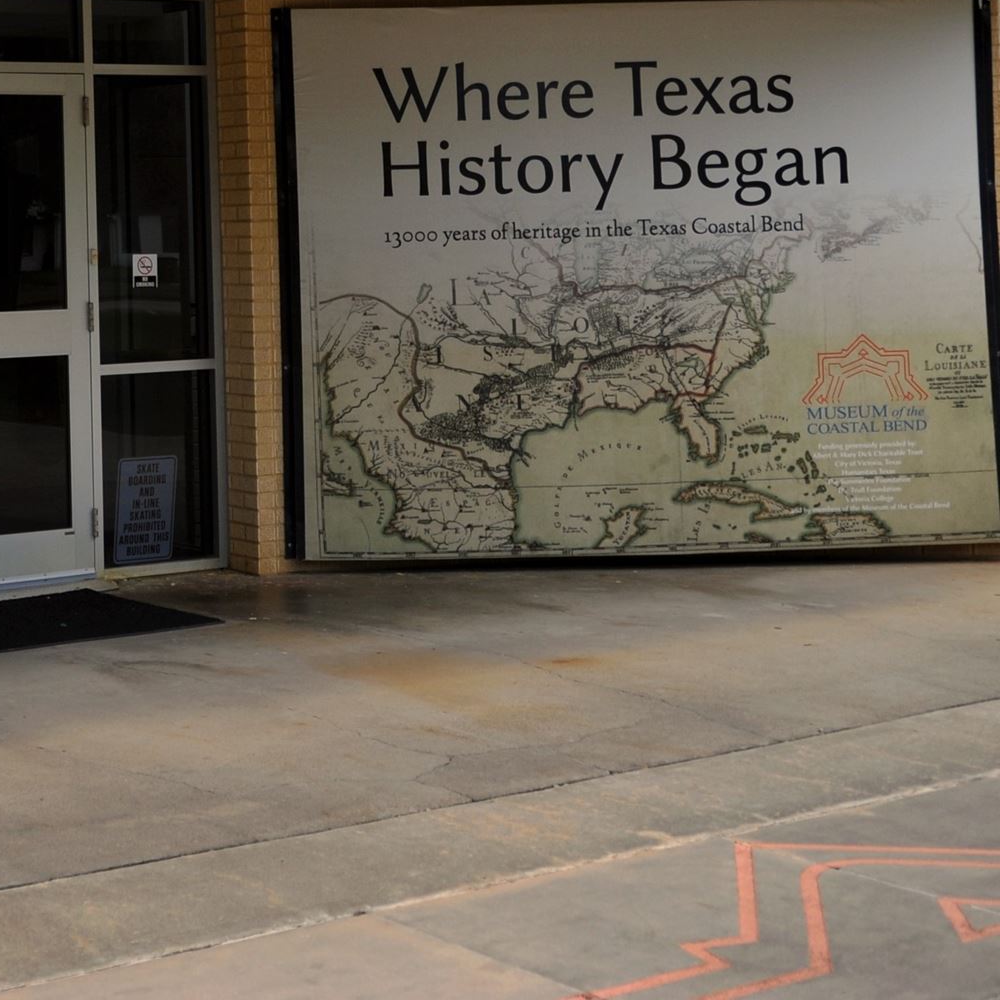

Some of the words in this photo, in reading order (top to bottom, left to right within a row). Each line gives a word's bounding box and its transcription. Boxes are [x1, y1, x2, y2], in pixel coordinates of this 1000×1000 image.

[372, 62, 594, 123] Where
[614, 61, 794, 117] Texas
[381, 140, 623, 211] History
[651, 134, 849, 206] Began
[384, 228, 437, 248] 13000
[442, 226, 486, 246] years
[490, 221, 511, 240] of
[511, 222, 581, 243] heritage
[585, 222, 602, 237] in
[606, 221, 633, 237] the
[636, 218, 687, 236] Texas
[691, 215, 756, 234] Coastal
[761, 213, 804, 232] Bend
[807, 405, 887, 420] MUSEUM
[891, 406, 904, 418] of
[905, 405, 925, 417] the
[807, 421, 880, 435] COASTAL
[883, 419, 928, 432] BEND
[137, 463, 160, 474] SKATE
[128, 474, 166, 486] BOARDING
[139, 487, 155, 497] AND
[132, 498, 160, 509] IN-LINE
[129, 509, 161, 521] SKATING
[123, 521, 166, 533] PROHIBITED
[119, 533, 149, 545] AROUND
[153, 532, 169, 543] THIS
[126, 544, 161, 556] BUILDING
